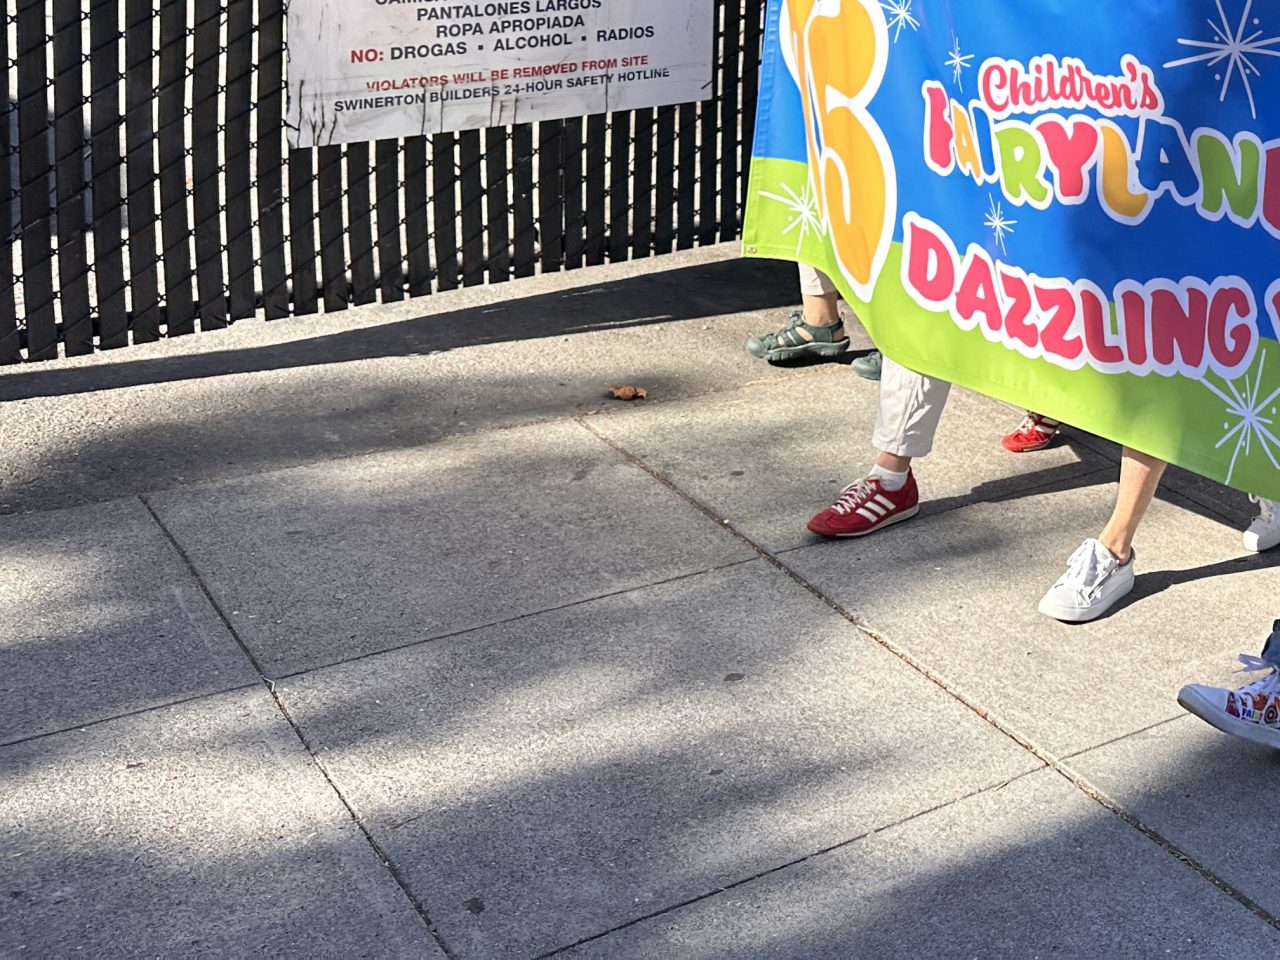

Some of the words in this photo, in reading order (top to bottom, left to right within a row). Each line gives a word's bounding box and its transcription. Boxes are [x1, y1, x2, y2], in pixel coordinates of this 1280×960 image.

[417, 1, 530, 21] PANTALONES
[436, 22, 484, 38] ROPA
[489, 14, 585, 34] APROPIADA
[350, 48, 384, 64] NO:
[390, 41, 467, 60] DROGAS
[493, 33, 573, 52] ALCOHOL
[597, 25, 654, 42] RADIOS
[334, 93, 425, 112] SWINERTON
[430, 86, 500, 104] BUILDERS
[504, 79, 563, 95] 24-HOUR
[566, 73, 614, 88] SAFETY
[618, 68, 670, 83] HOTLINE
[366, 75, 449, 92] VIOLATORS
[452, 71, 486, 84] WILL
[491, 69, 508, 81] BE
[513, 62, 578, 78] REMOVED
[581, 58, 617, 72] FROM
[621, 55, 648, 67] SITE
[982, 60, 1159, 111] Children's
[907, 220, 1252, 369] DAZZLING
